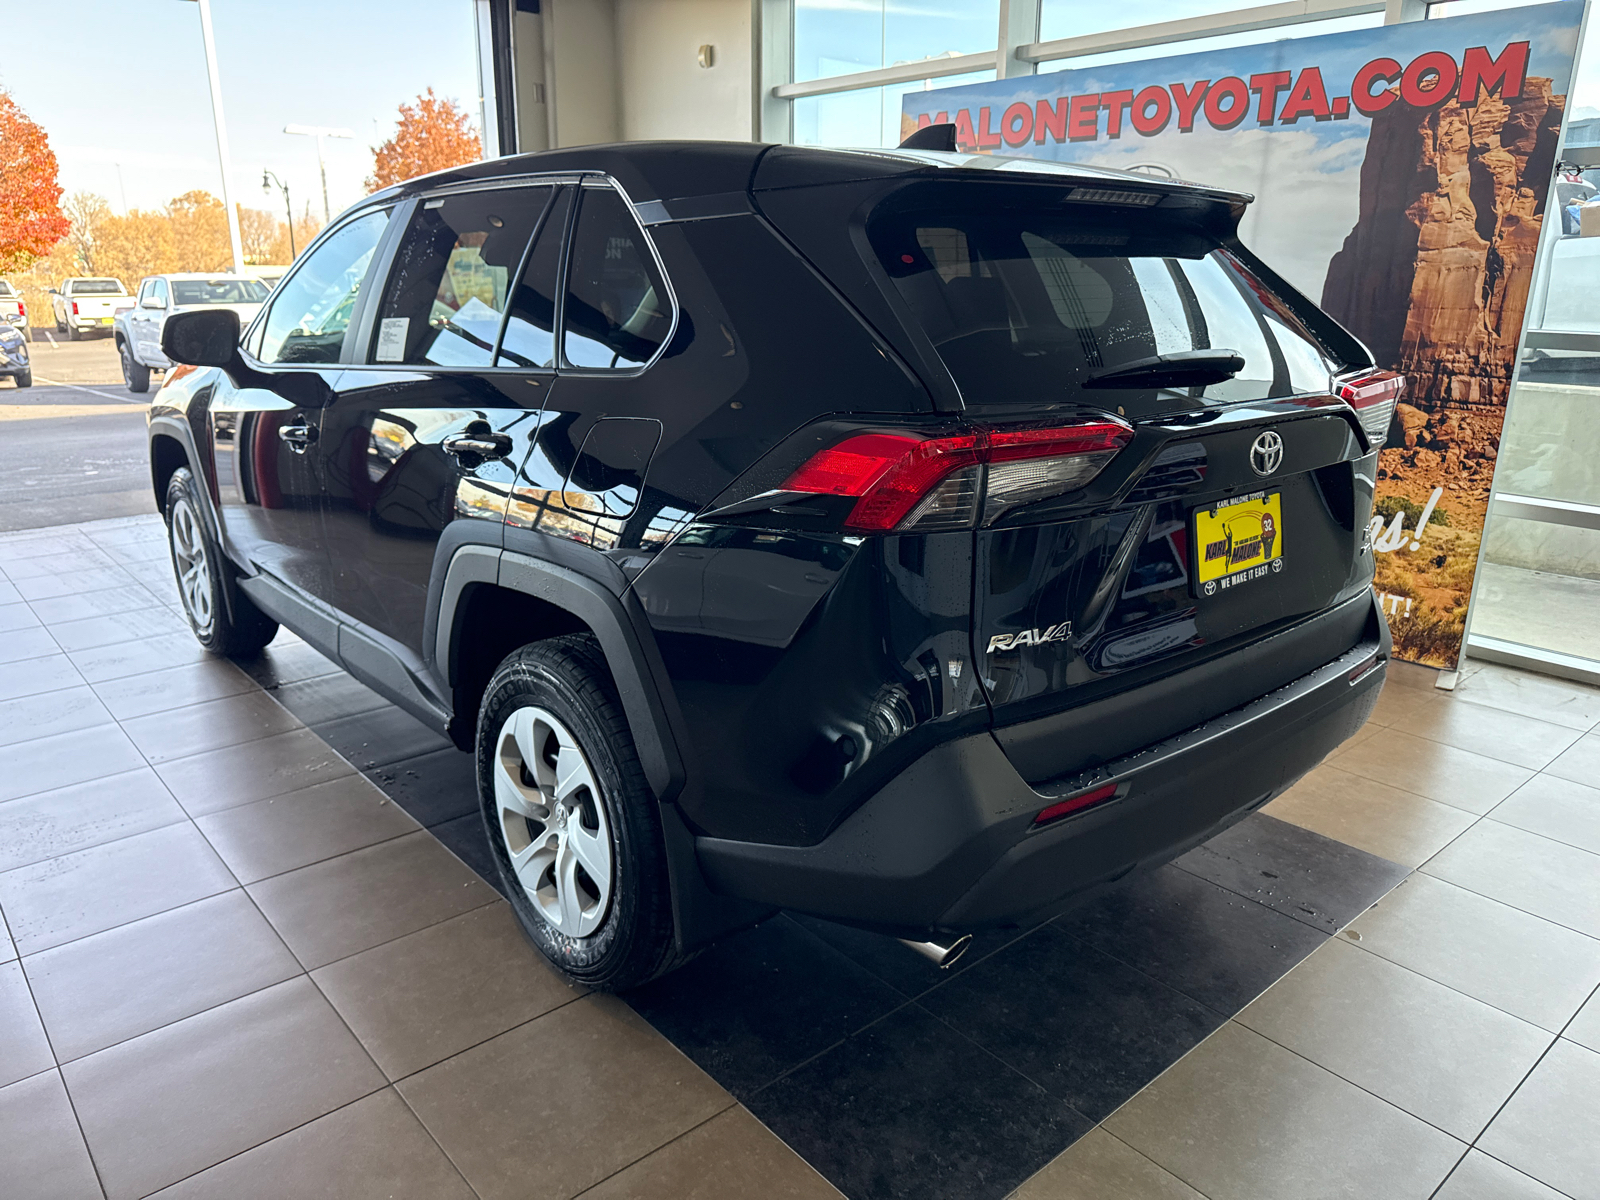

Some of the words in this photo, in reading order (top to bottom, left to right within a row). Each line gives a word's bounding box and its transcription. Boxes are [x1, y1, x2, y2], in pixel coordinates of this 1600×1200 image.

[1263, 519, 1272, 531] 32
[1205, 539, 1228, 562] KARL
[1230, 540, 1262, 565] MALONE
[1221, 577, 1230, 589] WE
[1231, 572, 1247, 586] MAKE
[1248, 569, 1254, 580] IT
[1255, 565, 1268, 578] EASY
[986, 621, 1072, 653] RAV4
